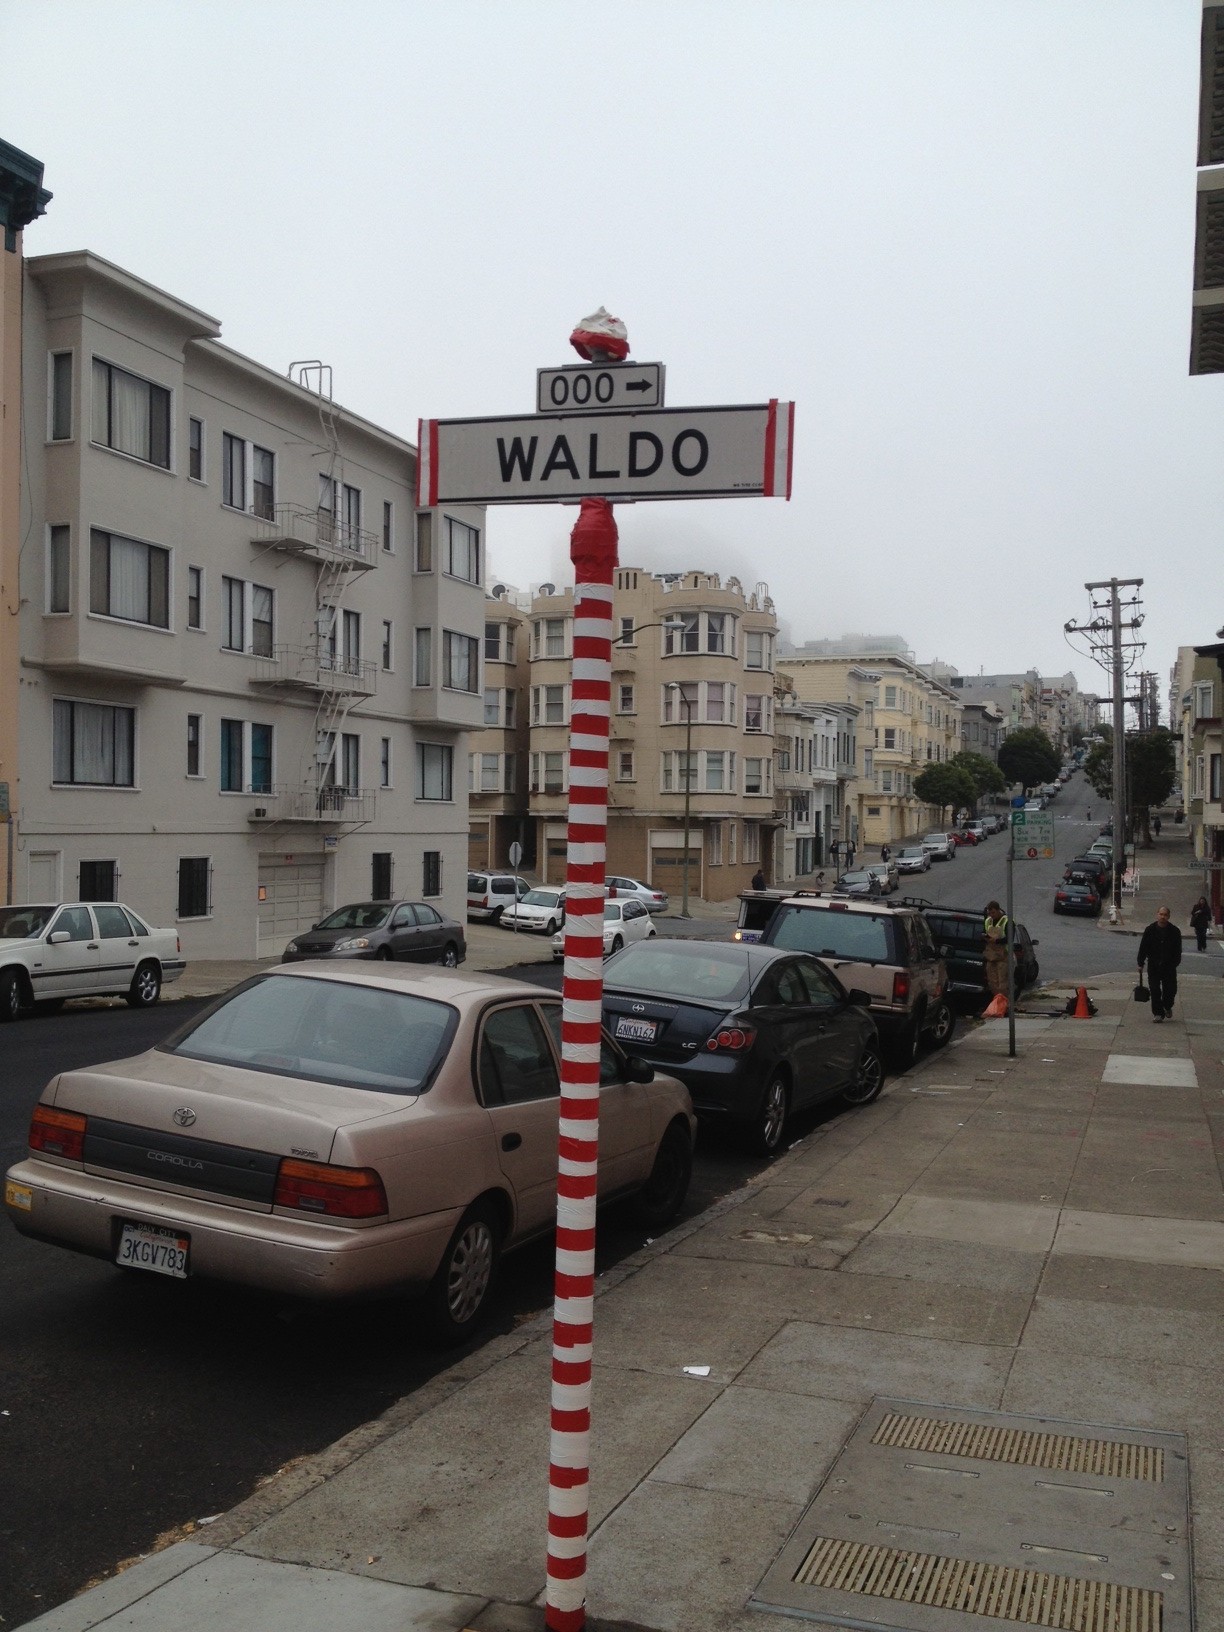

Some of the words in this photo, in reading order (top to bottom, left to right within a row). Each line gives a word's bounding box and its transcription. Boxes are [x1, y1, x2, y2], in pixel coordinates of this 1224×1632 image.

[551, 372, 615, 406] 000
[496, 428, 709, 483] WALDO
[1015, 813, 1023, 824] 2
[617, 1023, 655, 1040] 6NKN162
[146, 1150, 205, 1171] COROLLA
[137, 1223, 156, 1235] DALY
[158, 1228, 177, 1238] CITY
[122, 1238, 185, 1271] 3KGV783
